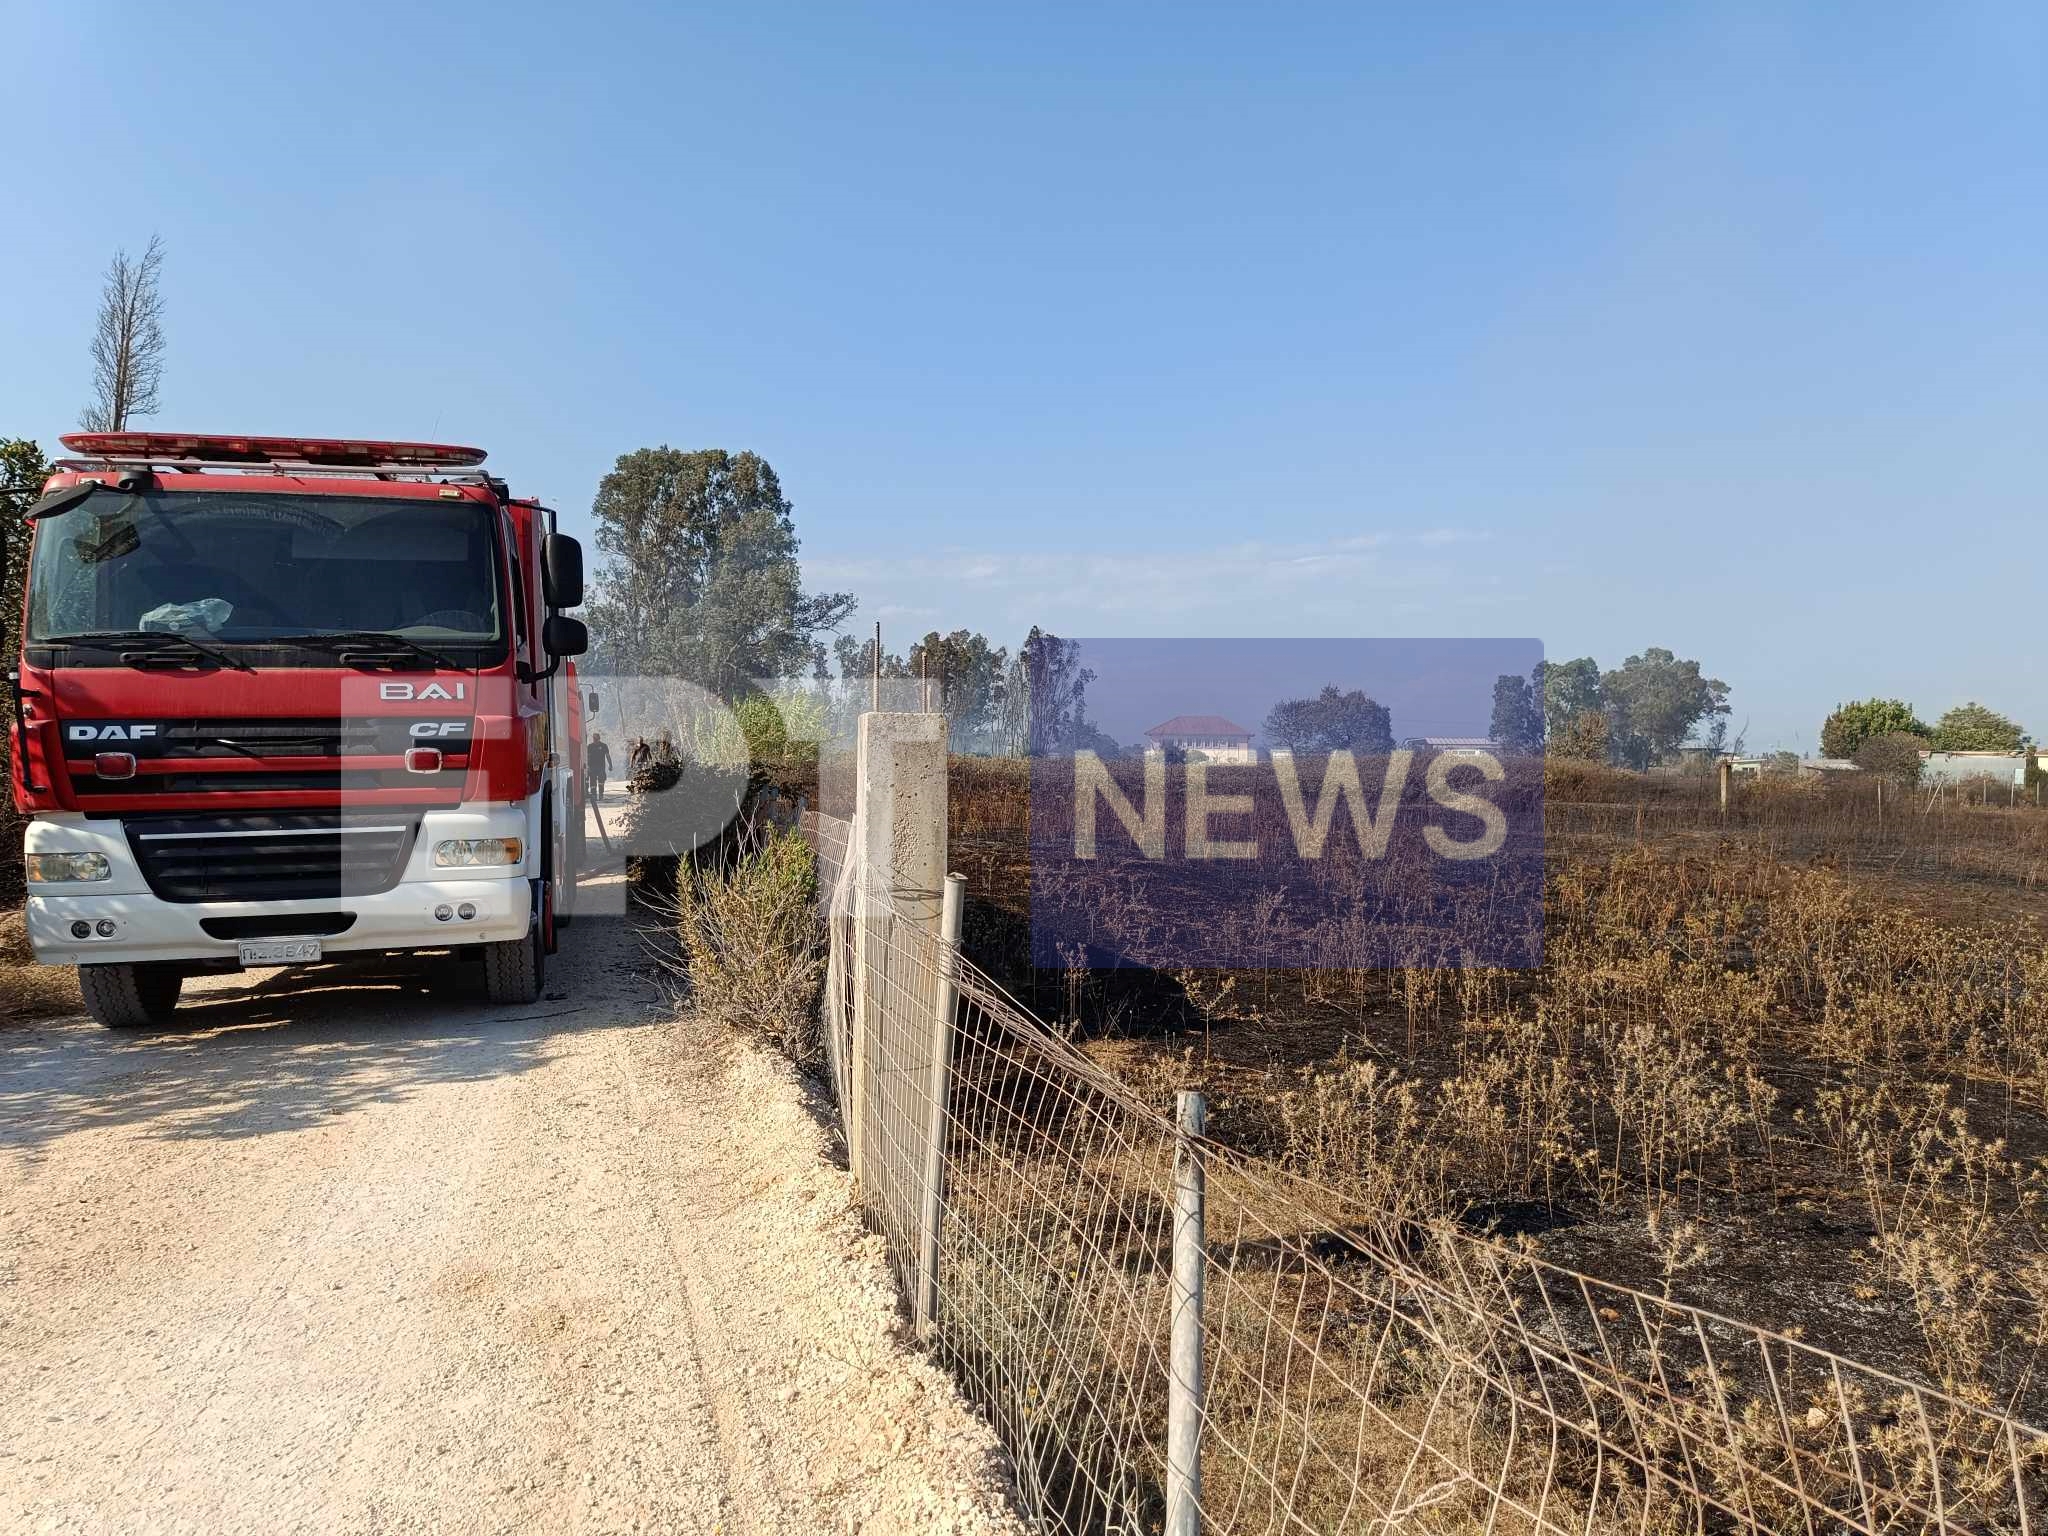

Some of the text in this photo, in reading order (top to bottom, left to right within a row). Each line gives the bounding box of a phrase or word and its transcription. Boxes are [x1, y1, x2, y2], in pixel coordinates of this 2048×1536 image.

[380, 682, 464, 700] BAI
[69, 725, 157, 741] DAF
[409, 722, 467, 737] CF
